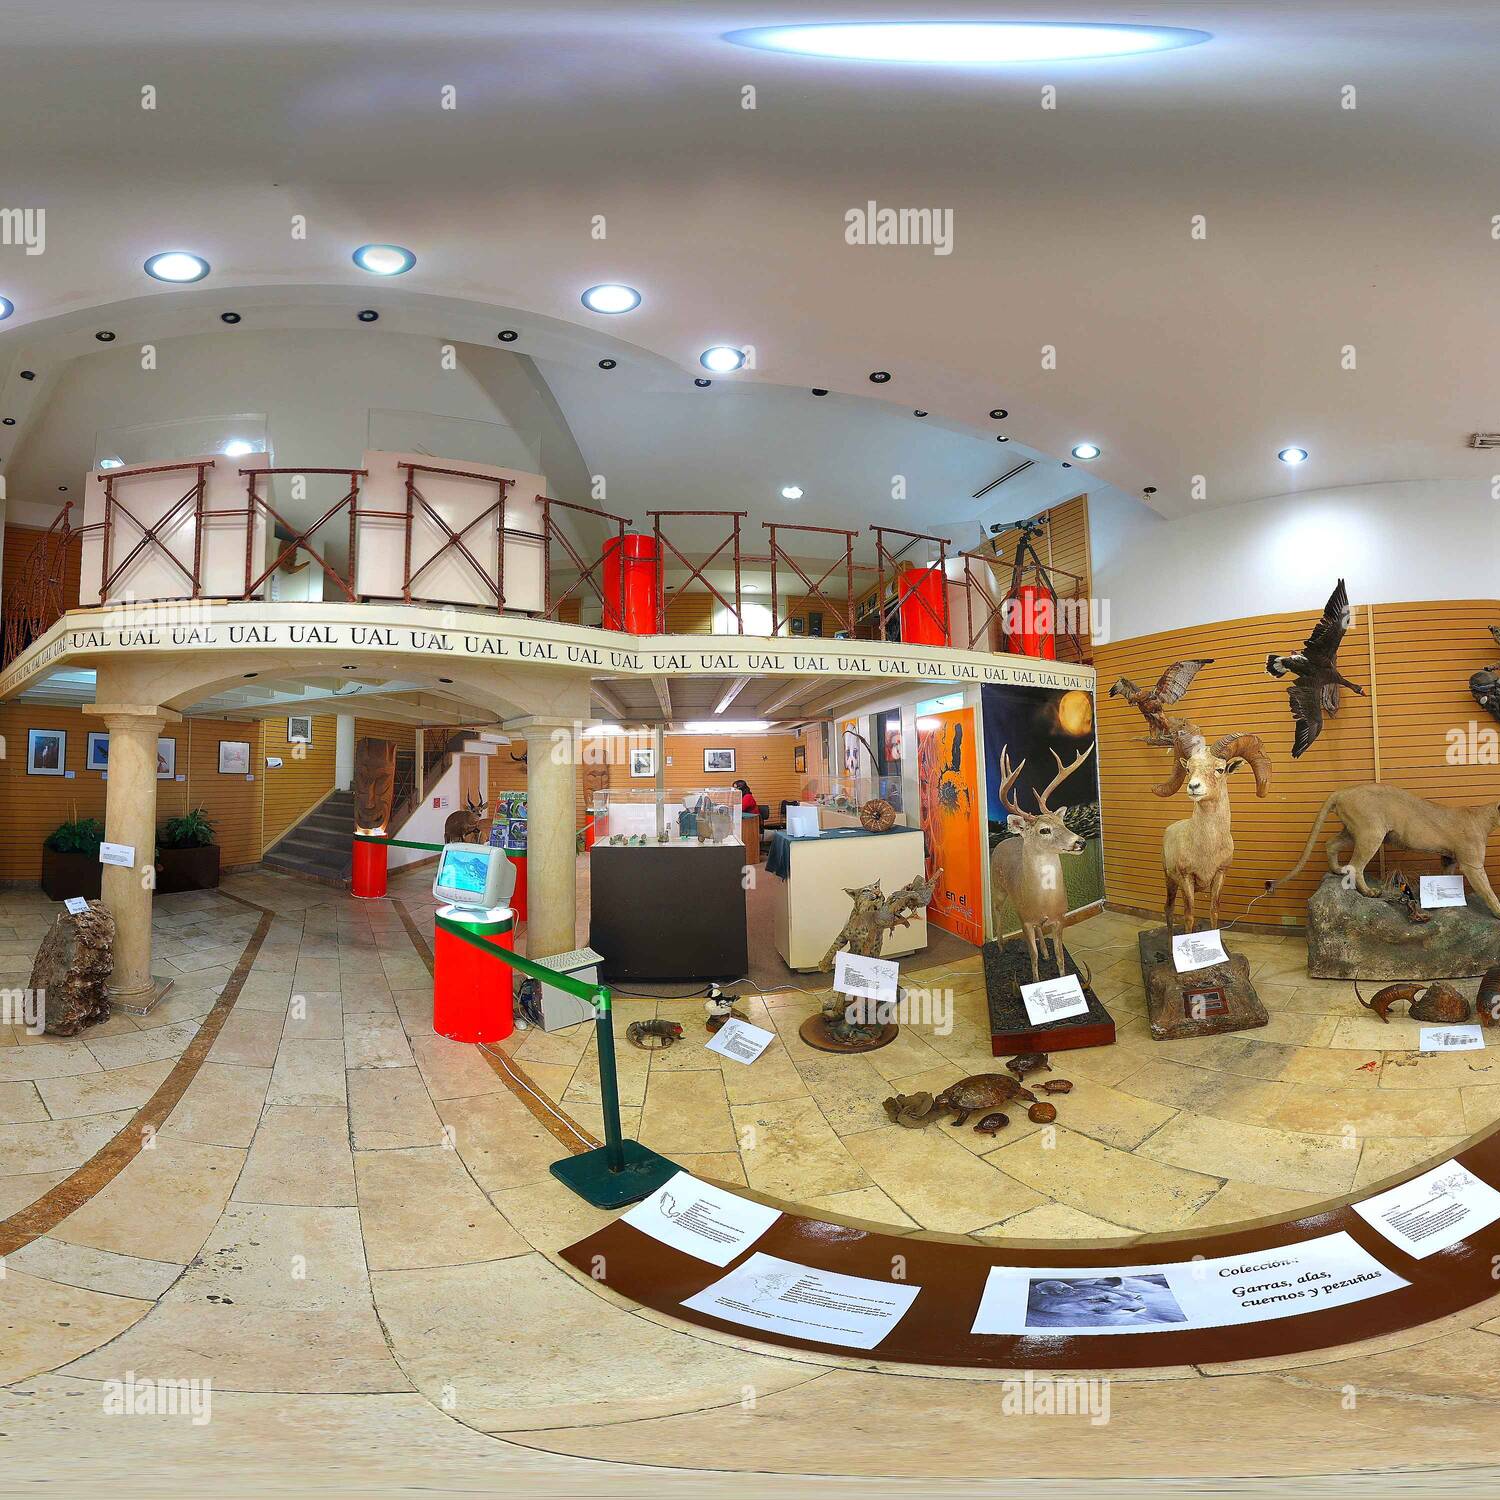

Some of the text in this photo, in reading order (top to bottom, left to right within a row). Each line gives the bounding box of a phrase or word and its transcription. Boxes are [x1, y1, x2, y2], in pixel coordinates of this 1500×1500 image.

[54, 637, 67, 657] UAL
[72, 628, 111, 648] UAL
[118, 627, 160, 646] UAL
[173, 628, 217, 647] UAL
[228, 626, 277, 643] UAL
[288, 626, 338, 643] UAL
[351, 627, 399, 646] UAL
[411, 631, 454, 651] UAL
[464, 636, 508, 655] UAL
[518, 641, 558, 660] UAL
[567, 646, 602, 665] UAL
[610, 652, 644, 670] UAL
[653, 655, 692, 670] UAL
[701, 655, 739, 669] UAL
[748, 655, 784, 670] UAL
[793, 656, 830, 671] UAL
[837, 658, 871, 672] UAL
[879, 660, 910, 674] UAL
[917, 663, 946, 676] UAL
[952, 665, 978, 679] UAL
[984, 668, 1008, 681] UAL
[1013, 670, 1035, 683] UAL
[1039, 673, 1060, 686] UAL
[1063, 676, 1082, 689] UAL
[1231, 1271, 1331, 1297] Garras, alas,
[1241, 1270, 1382, 1308] cuernos y pezuñas
